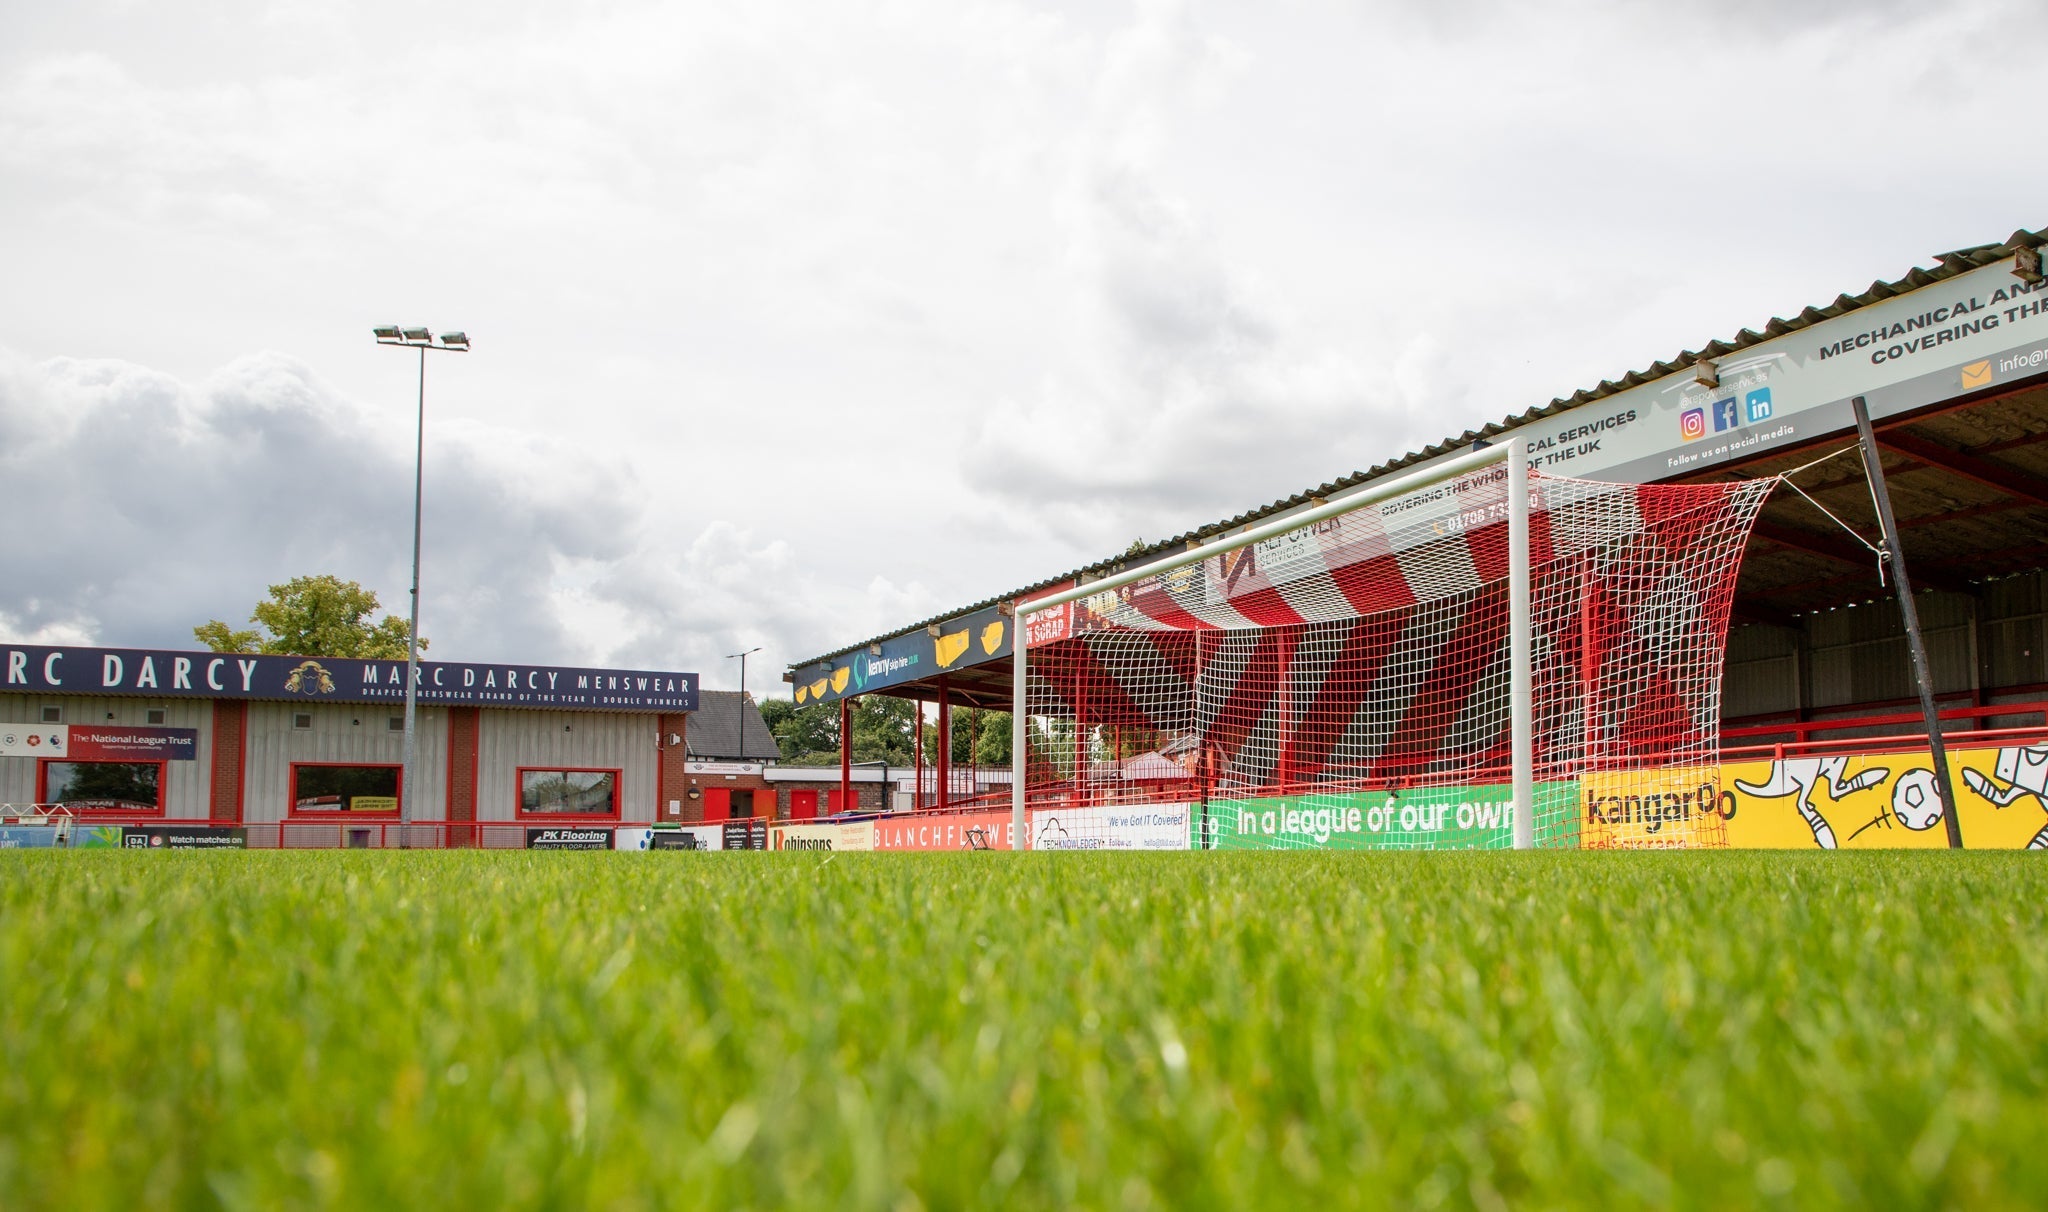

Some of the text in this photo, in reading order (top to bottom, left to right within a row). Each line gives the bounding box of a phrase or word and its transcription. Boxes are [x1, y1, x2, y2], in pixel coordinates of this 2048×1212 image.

[1820, 297, 1985, 361] MECHANICAL
[1871, 315, 2000, 365] COVERING
[1558, 409, 1637, 444] SERVICES
[1545, 447, 1576, 465] THE
[1578, 439, 1602, 456] UK
[1667, 425, 1794, 468] Follow us on social media
[1381, 489, 1443, 516] COVERING
[1444, 480, 1470, 497] THE
[1448, 508, 1485, 531] 01708
[1034, 619, 1064, 643] SCRAP
[8, 650, 258, 692] RC DARCY
[363, 664, 689, 693] MARC DARCY MENSWEAR
[868, 659, 890, 677] kenny
[417, 690, 472, 699] MENSWEAR
[479, 693, 513, 701] BRAND
[519, 693, 531, 701] OF
[538, 694, 555, 702] THE
[561, 695, 585, 703] YEAR
[603, 696, 640, 705] DOUBLE
[647, 698, 689, 706] WINNERS
[72, 733, 192, 745] The National League Trust
[1129, 815, 1143, 827] Got
[1143, 814, 1152, 825] IT
[1237, 806, 1257, 835] In
[1261, 811, 1276, 835] a
[1280, 802, 1362, 843] league
[1367, 797, 1394, 832] of
[1399, 803, 1449, 831] our
[1587, 782, 1738, 835] kangaroo
[169, 835, 195, 844] Watch
[195, 835, 231, 844] matches
[542, 830, 607, 841] PK Flooring
[874, 821, 1033, 847] BLANCHFLOWER
